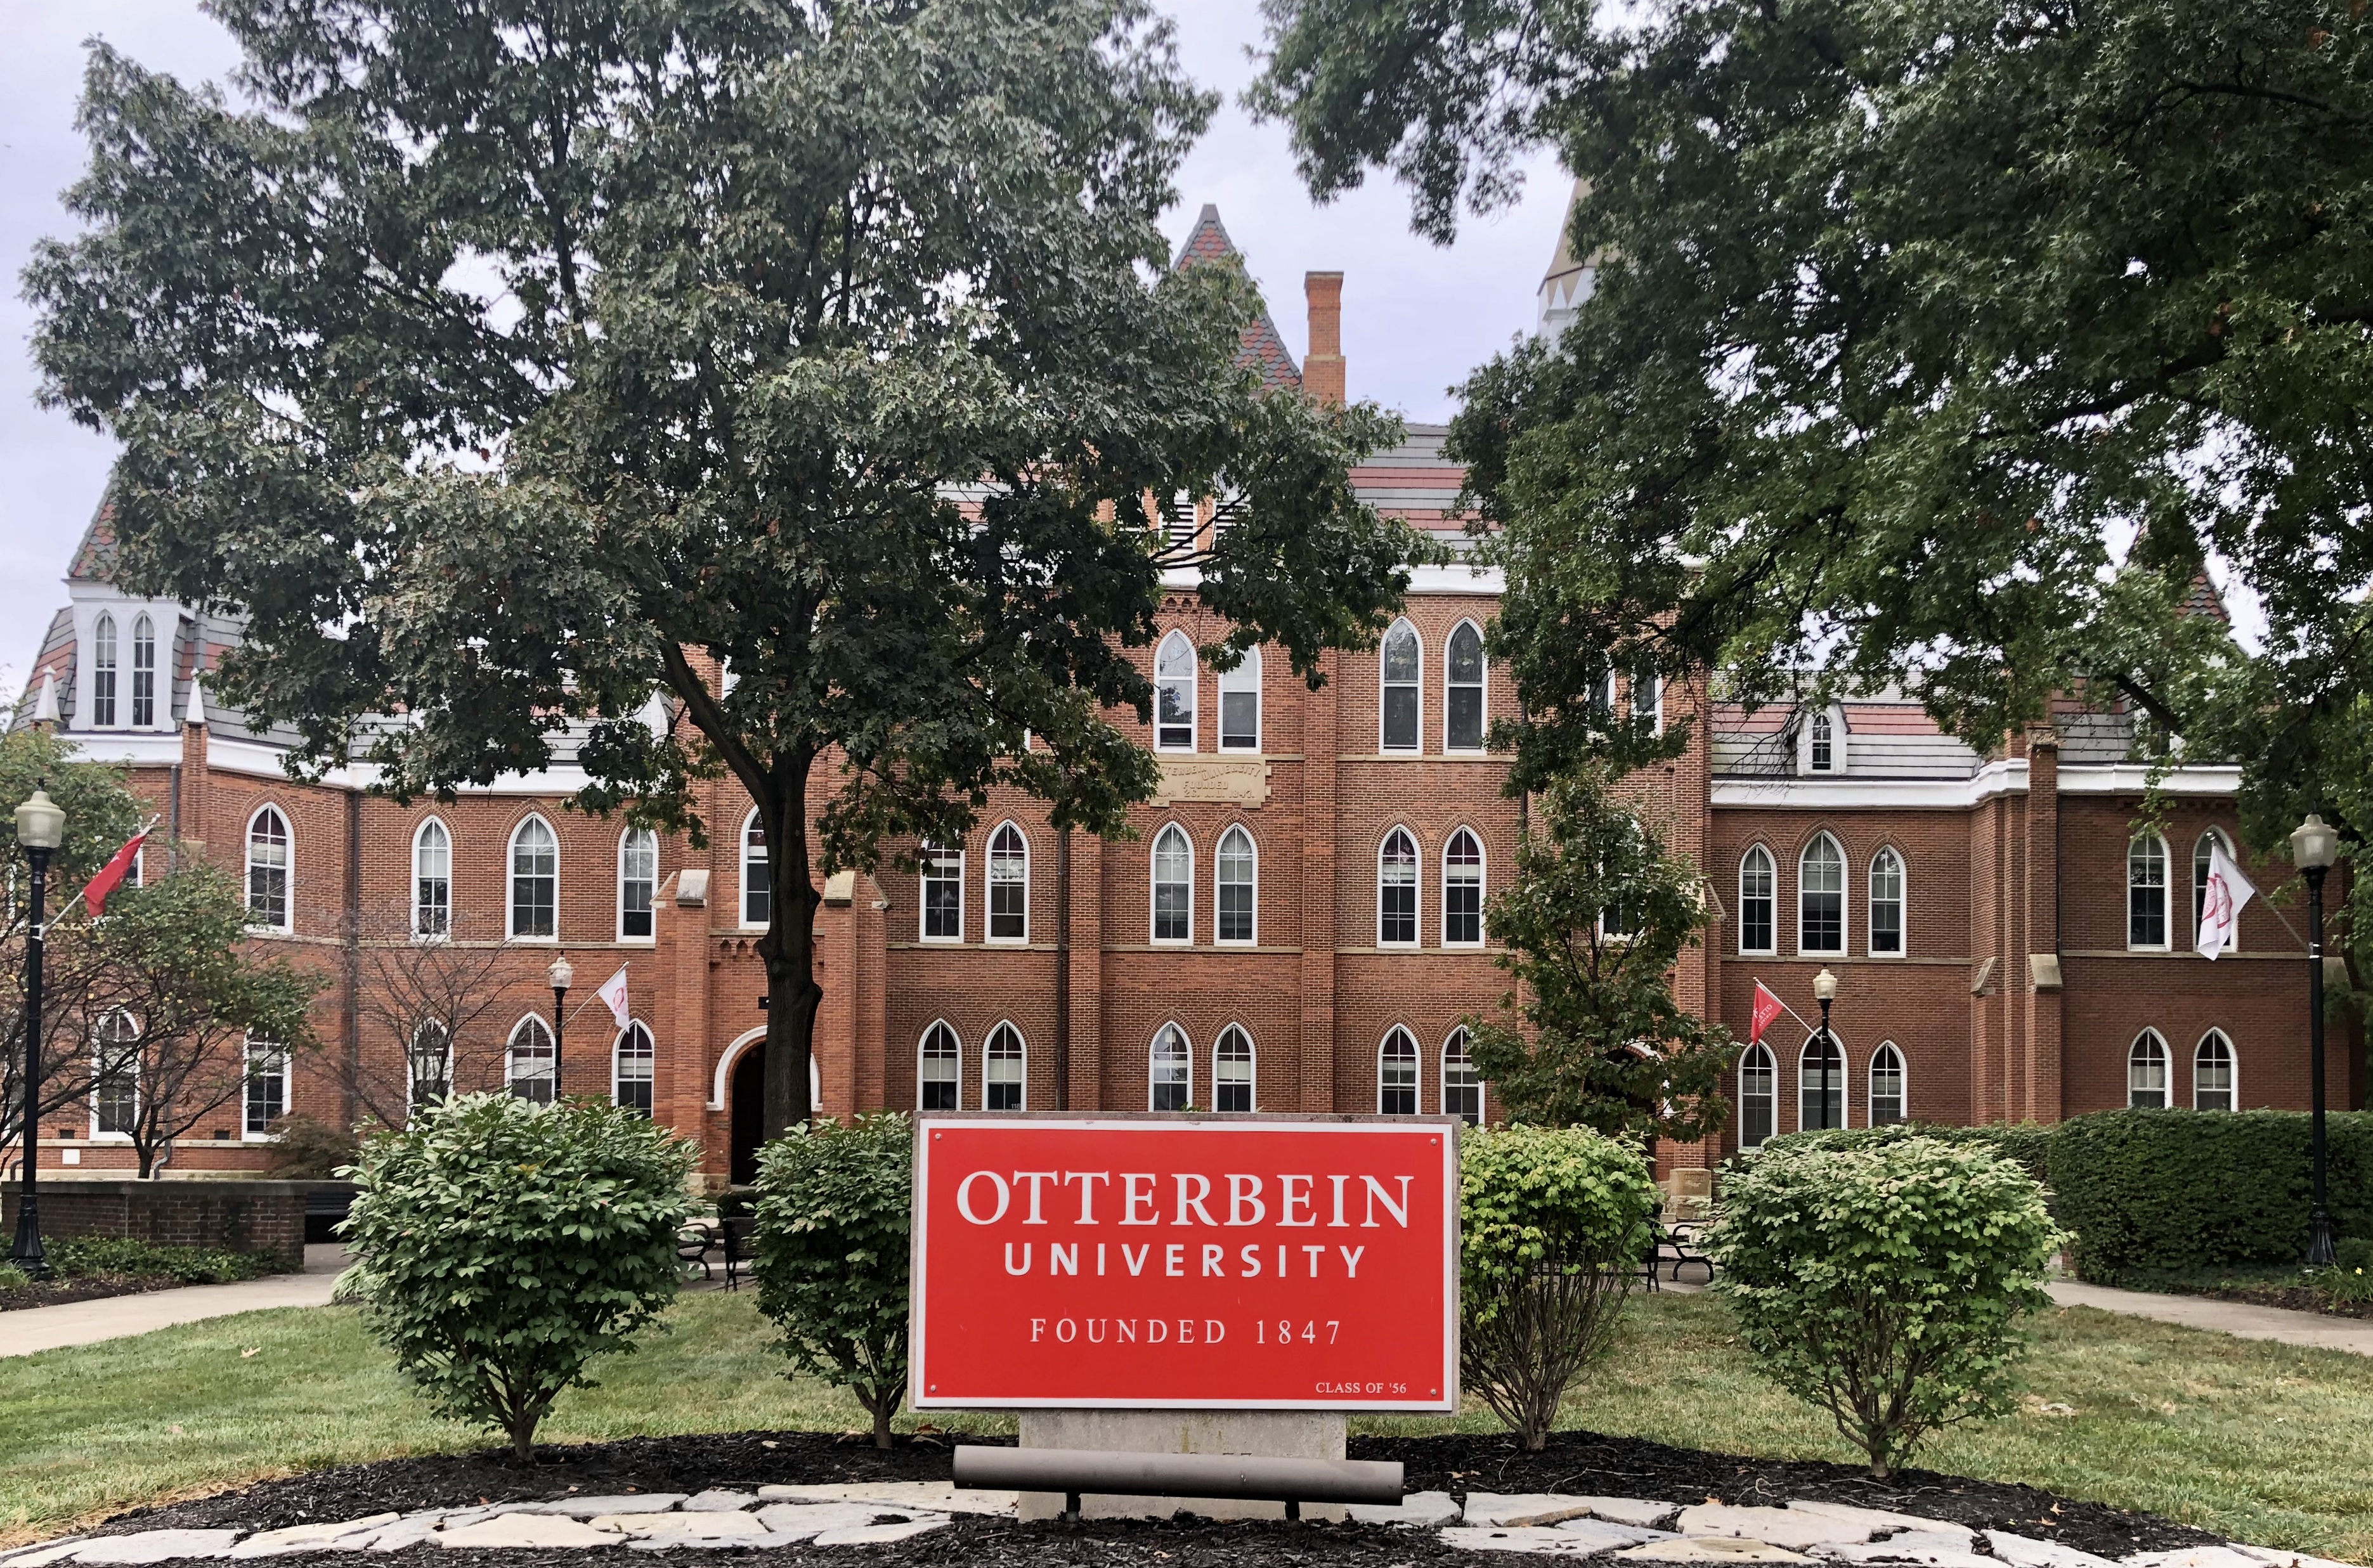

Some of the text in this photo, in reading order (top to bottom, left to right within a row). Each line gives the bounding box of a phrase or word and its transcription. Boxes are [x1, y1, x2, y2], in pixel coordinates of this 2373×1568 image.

[1159, 763, 1261, 781] TTERBEIN UNIVERSITY
[1183, 781, 1228, 789] FOUNDED
[956, 1170, 1414, 1228] OTTERBEIN
[1004, 1242, 1365, 1278] UNIVERSITY
[1030, 1318, 1340, 1345] FOUNDED 1847
[1315, 1382, 1407, 1394] CLASS OF '56
